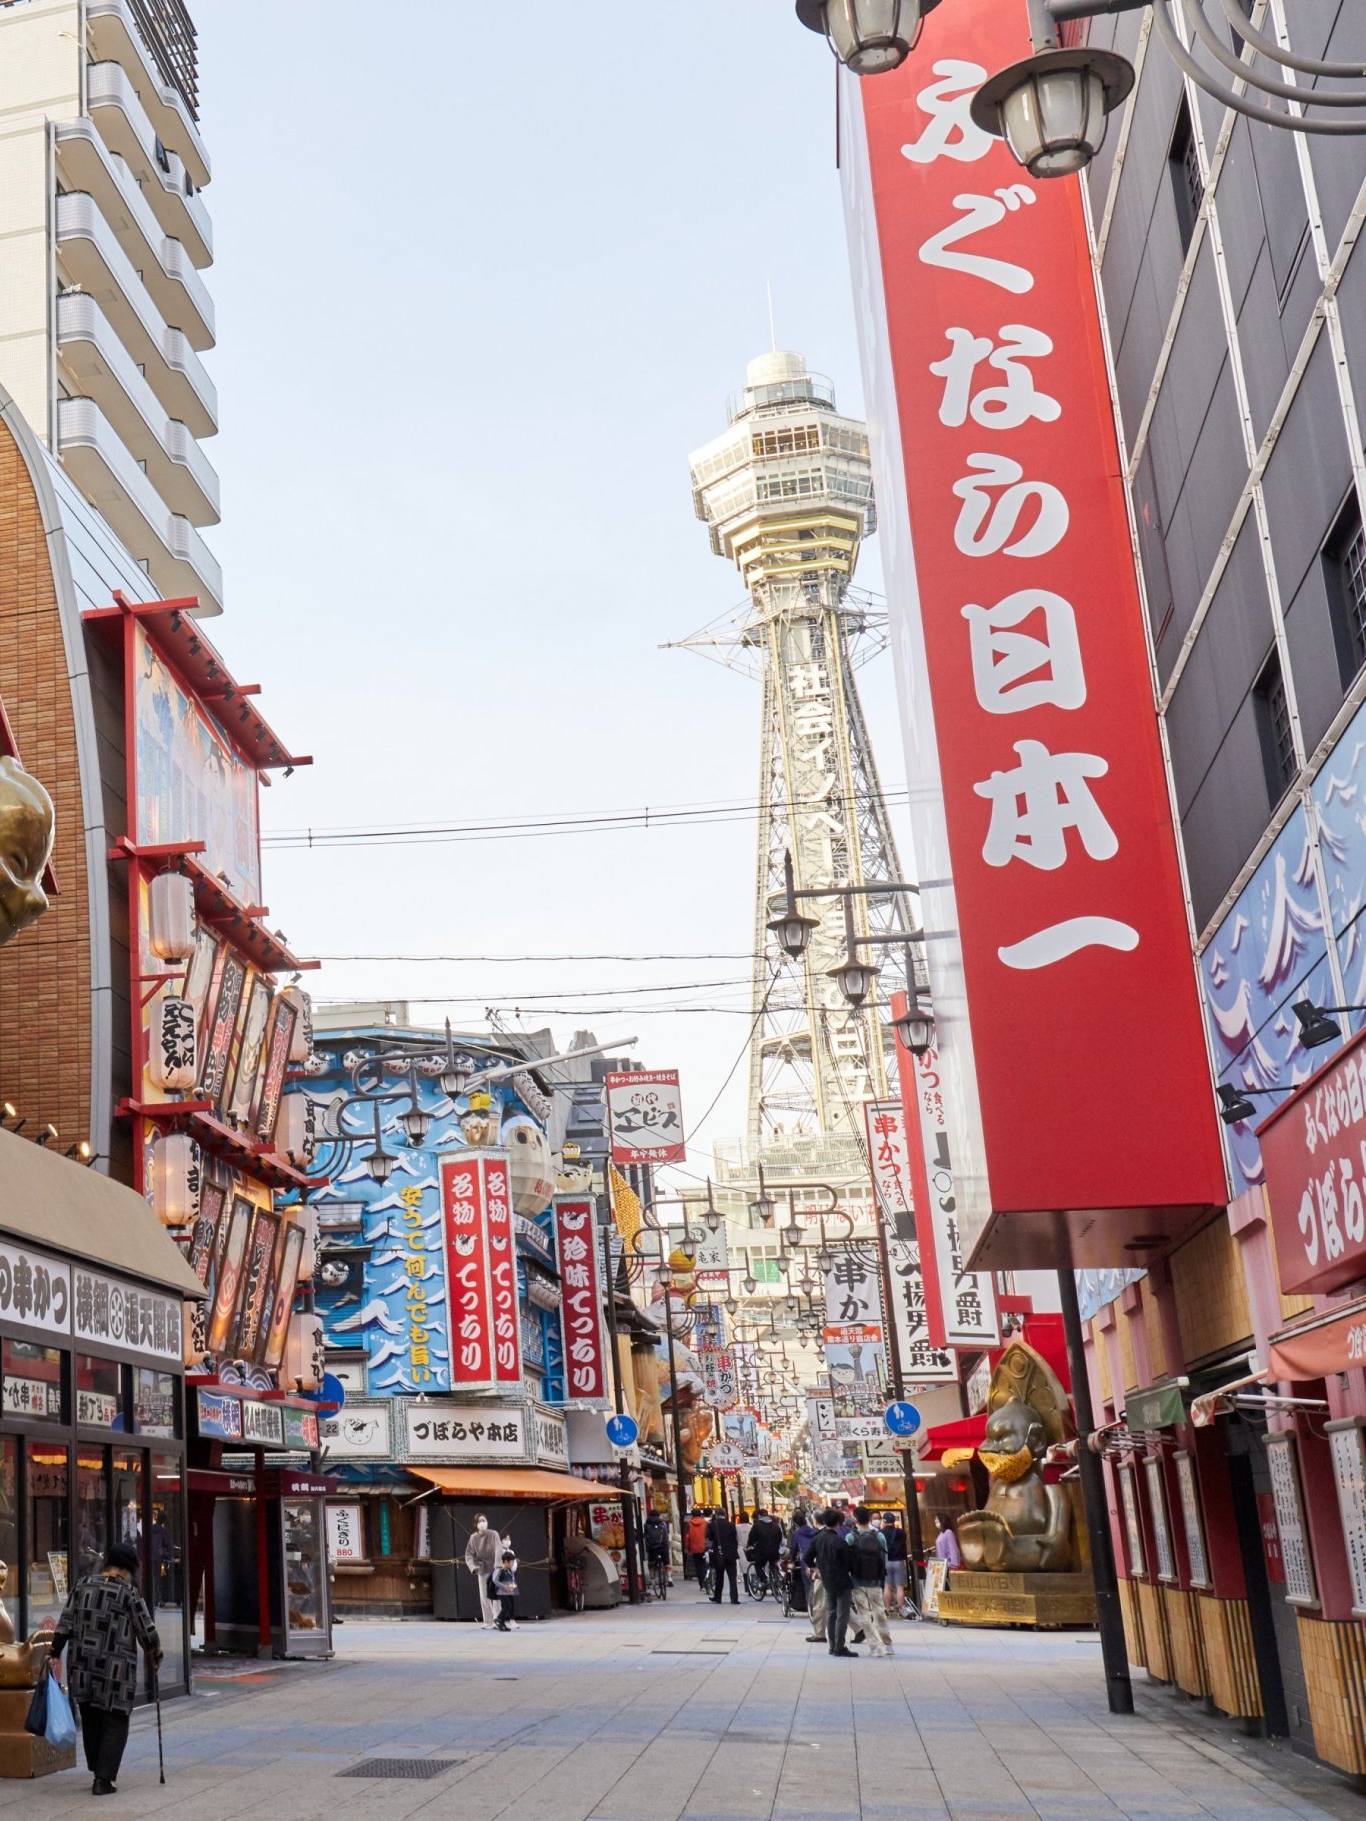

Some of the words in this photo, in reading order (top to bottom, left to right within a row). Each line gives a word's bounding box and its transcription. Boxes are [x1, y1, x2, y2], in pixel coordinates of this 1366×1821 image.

[901, 59, 1140, 970] ふぐなら日本一
[934, 1091, 944, 1125] 食べる
[630, 1147, 669, 1159] 年中無休
[874, 1114, 901, 1177] 串かつ
[451, 1174, 474, 1225] 名物
[487, 1172, 507, 1224] 名物
[1298, 1140, 1366, 1266] づぼら
[698, 1250, 722, 1264] 亀家
[76, 1272, 109, 1339] 横綱
[124, 1291, 181, 1356] 通天閣店
[456, 1263, 482, 1371] てっちり
[492, 1263, 514, 1370] てっちり
[564, 1238, 596, 1393] 珍味てっちり
[833, 1257, 869, 1326] 串か
[717, 1355, 734, 1395] 串かつ
[244, 1405, 281, 1440] 24時間営業
[413, 1420, 519, 1442] づぼらや本店
[894, 1439, 918, 1448] 9-22
[614, 1449, 633, 1457] 9-22
[336, 1548, 353, 1557] 880
